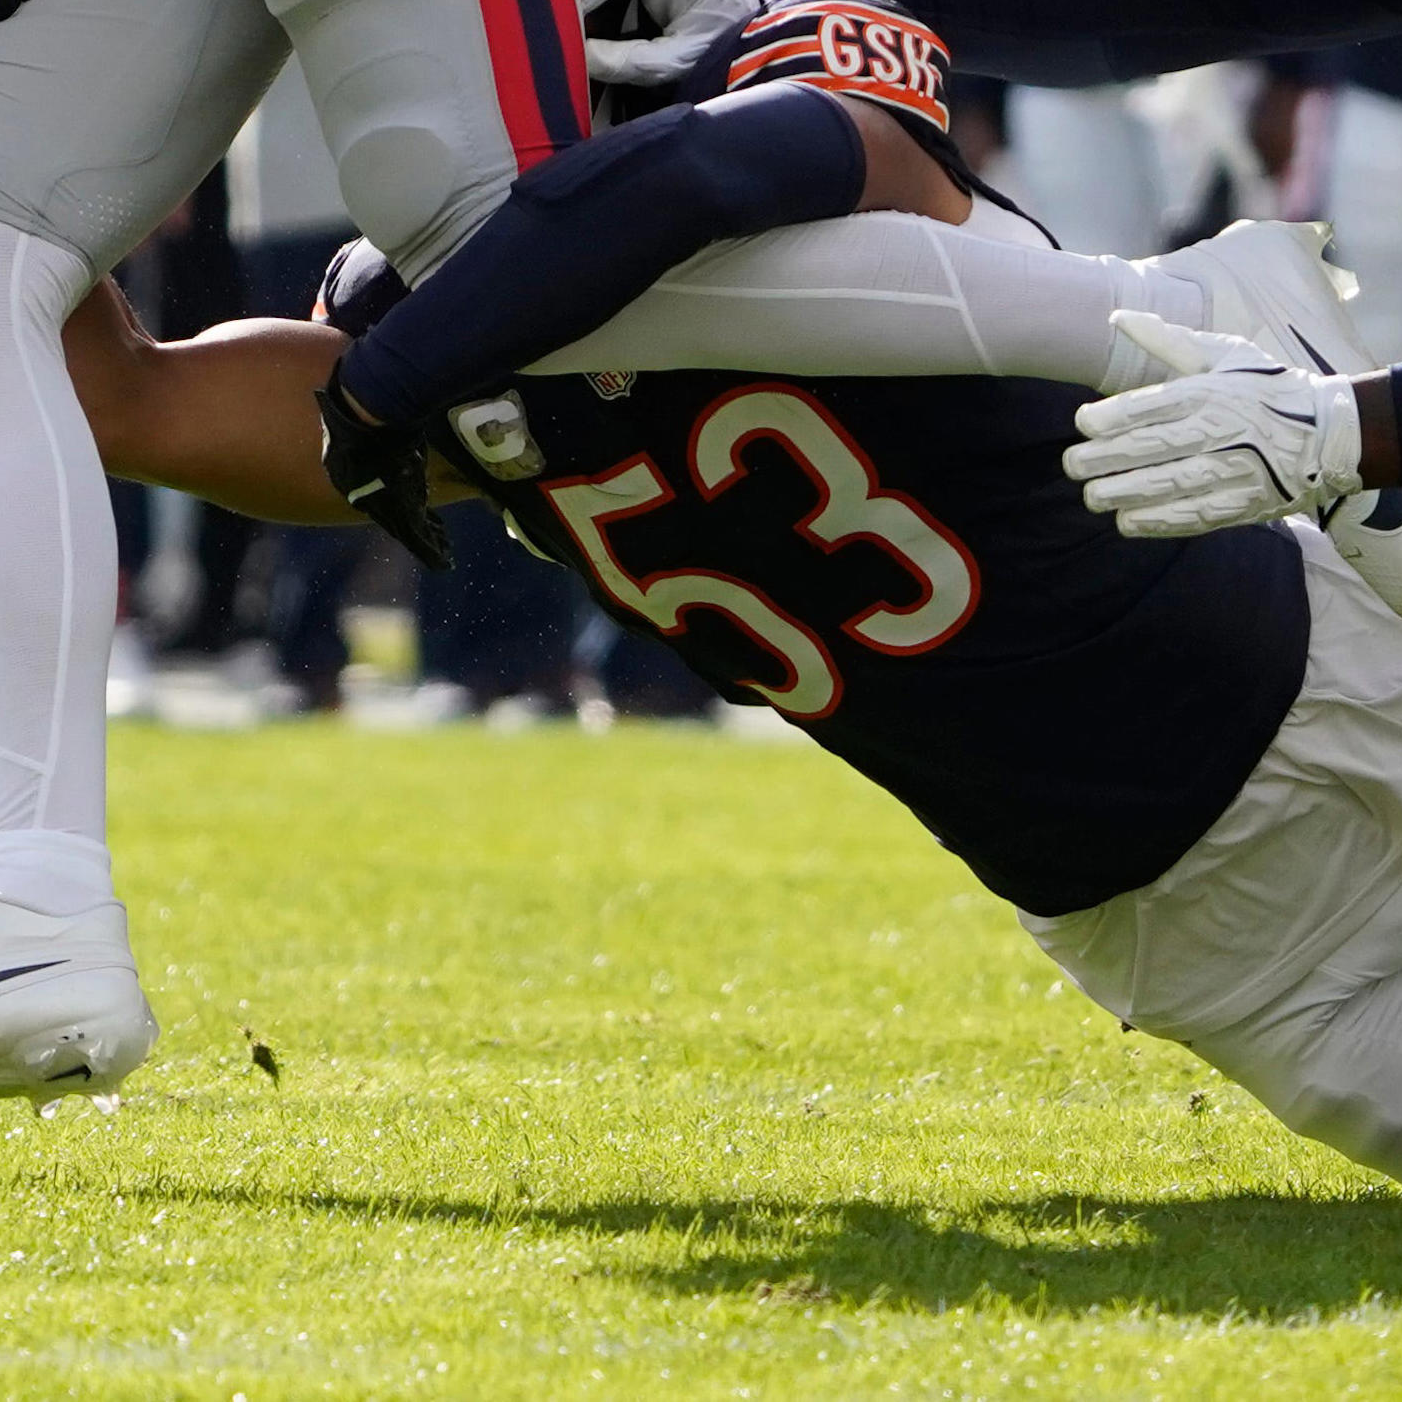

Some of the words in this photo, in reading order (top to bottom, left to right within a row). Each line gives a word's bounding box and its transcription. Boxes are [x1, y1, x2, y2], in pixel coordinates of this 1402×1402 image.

[818, 11, 944, 100] GSH
[458, 399, 527, 464] C
[539, 381, 982, 720] 53
